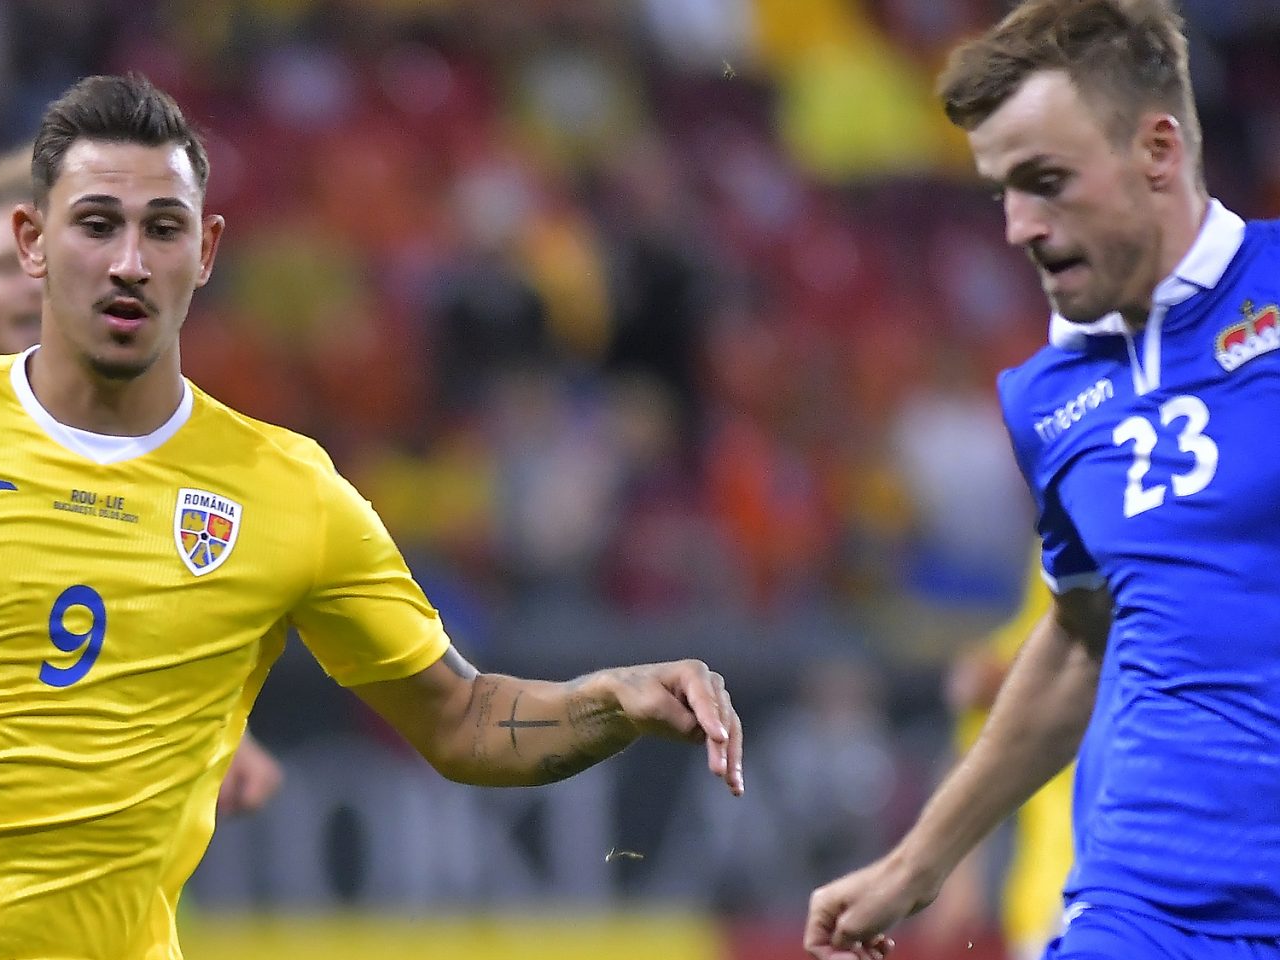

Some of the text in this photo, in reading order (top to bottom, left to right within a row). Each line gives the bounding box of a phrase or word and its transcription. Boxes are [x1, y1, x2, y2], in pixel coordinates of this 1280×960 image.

[1033, 378, 1114, 441] macron
[1112, 395, 1219, 518] 23
[71, 489, 97, 505] ROU
[106, 495, 125, 510] LIE
[184, 493, 235, 518] ROMÂNIA
[38, 584, 107, 688] 9
